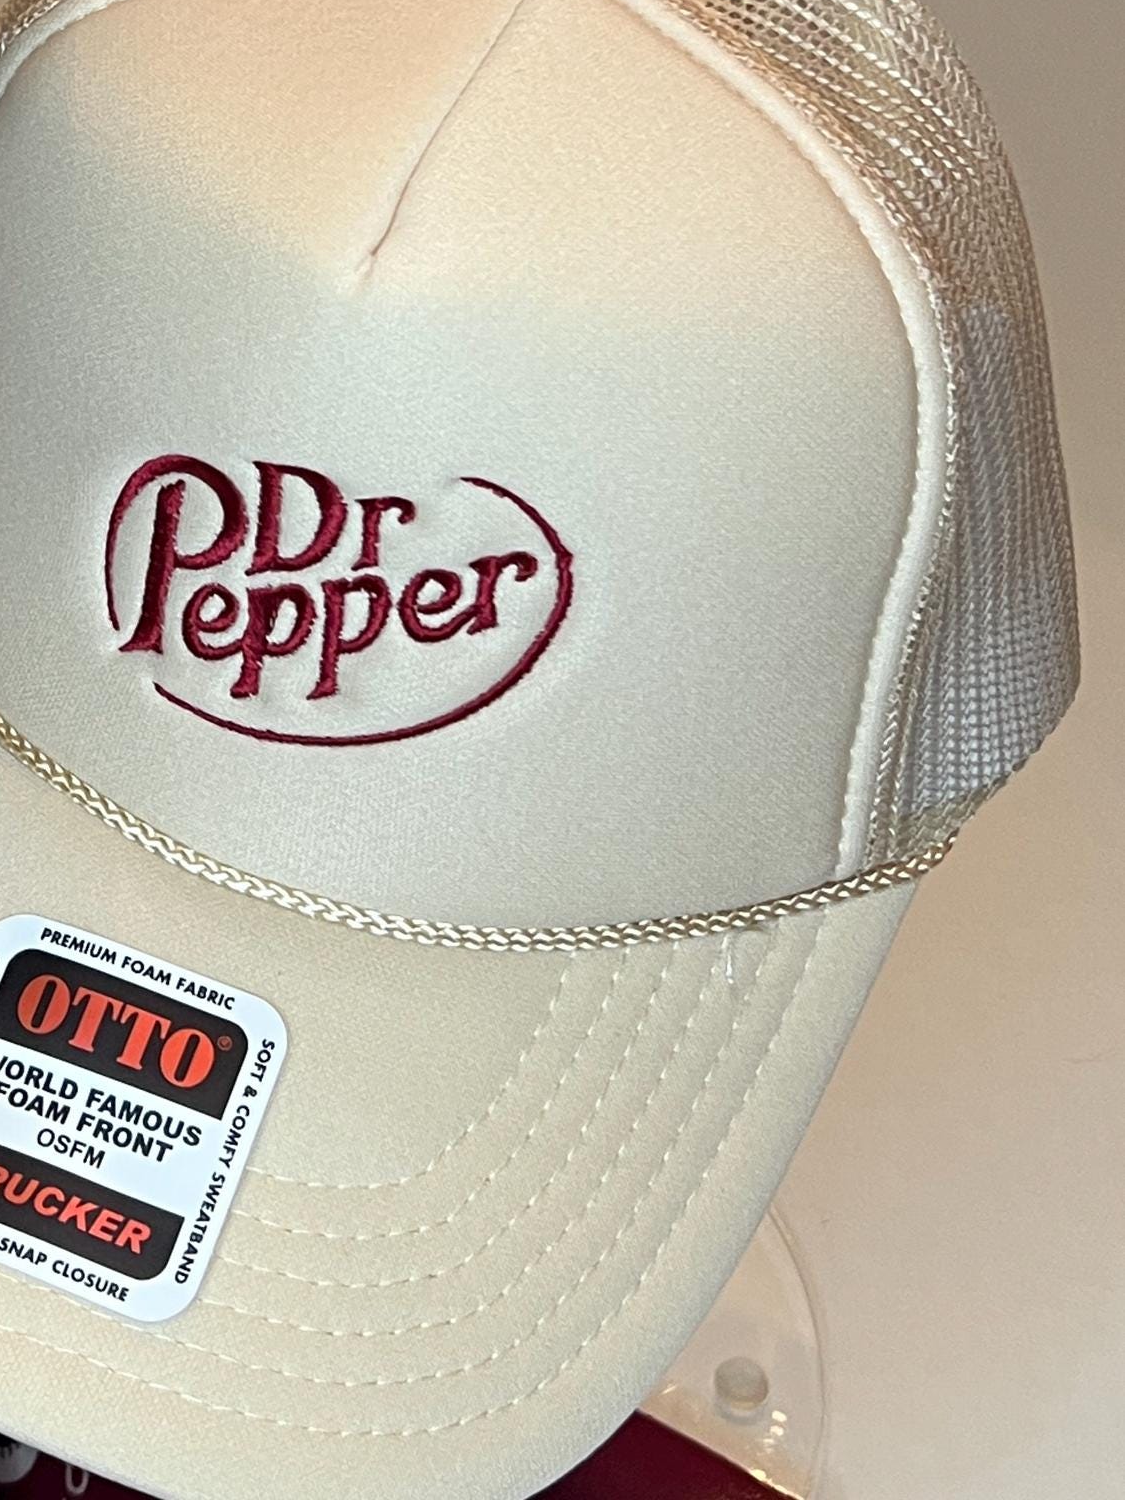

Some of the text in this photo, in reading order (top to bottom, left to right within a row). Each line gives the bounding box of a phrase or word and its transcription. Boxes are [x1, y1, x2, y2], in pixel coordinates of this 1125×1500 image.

[245, 460, 417, 577] Dr
[104, 453, 539, 700] Pepper
[39, 926, 236, 1011] PREMIUM FOAM FABRIC
[36, 1128, 106, 1170] OSFM
[75, 1112, 174, 1163] FRONT
[85, 1088, 203, 1147] FAMOUS
[174, 1038, 276, 1285] SOFT & COMFY SWEATBAND
[52, 1258, 130, 1303] CLOSURE
